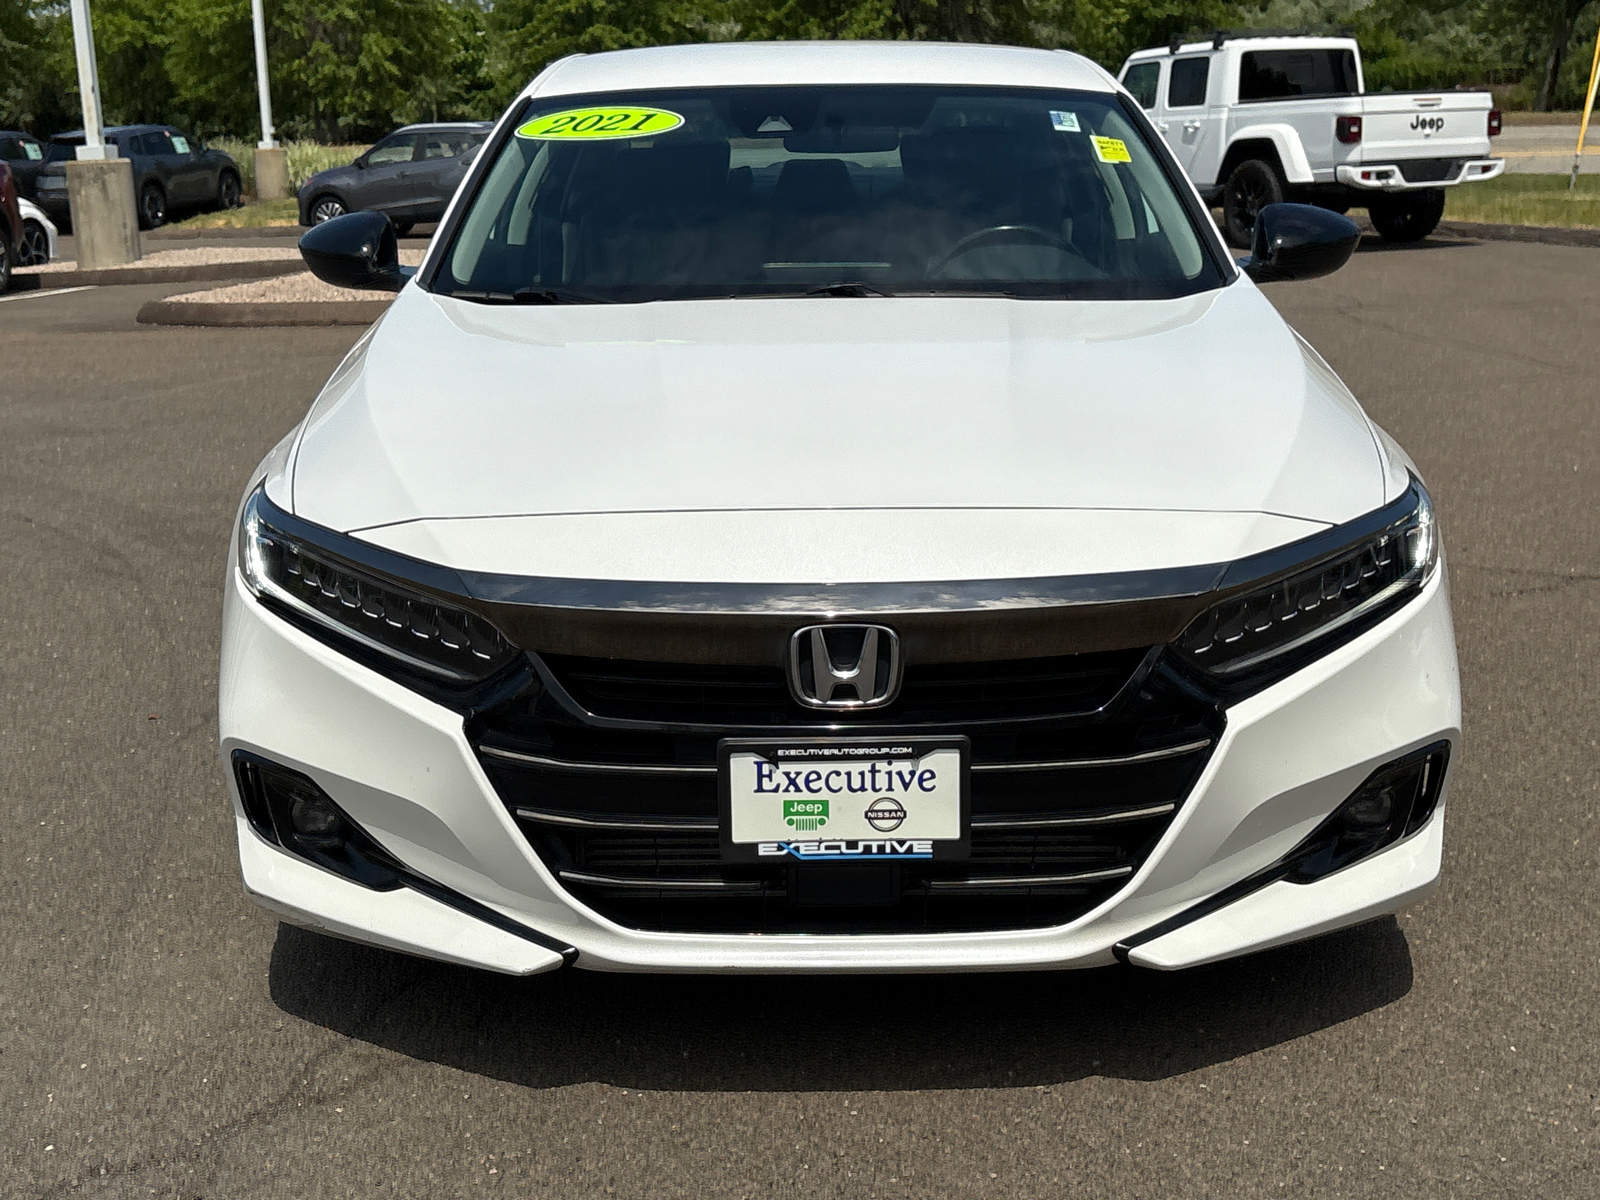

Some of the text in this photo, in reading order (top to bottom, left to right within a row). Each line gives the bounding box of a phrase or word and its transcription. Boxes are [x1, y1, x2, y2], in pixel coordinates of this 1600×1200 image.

[539, 113, 659, 135] 2021
[1410, 115, 1444, 132] Jeep
[777, 747, 913, 756] EXECUTIVEAUTOGROUP.COM
[753, 760, 937, 793] Executive
[790, 801, 823, 814] Jeep
[867, 810, 904, 818] NISSAN
[758, 840, 933, 859] EXECUTIVE
